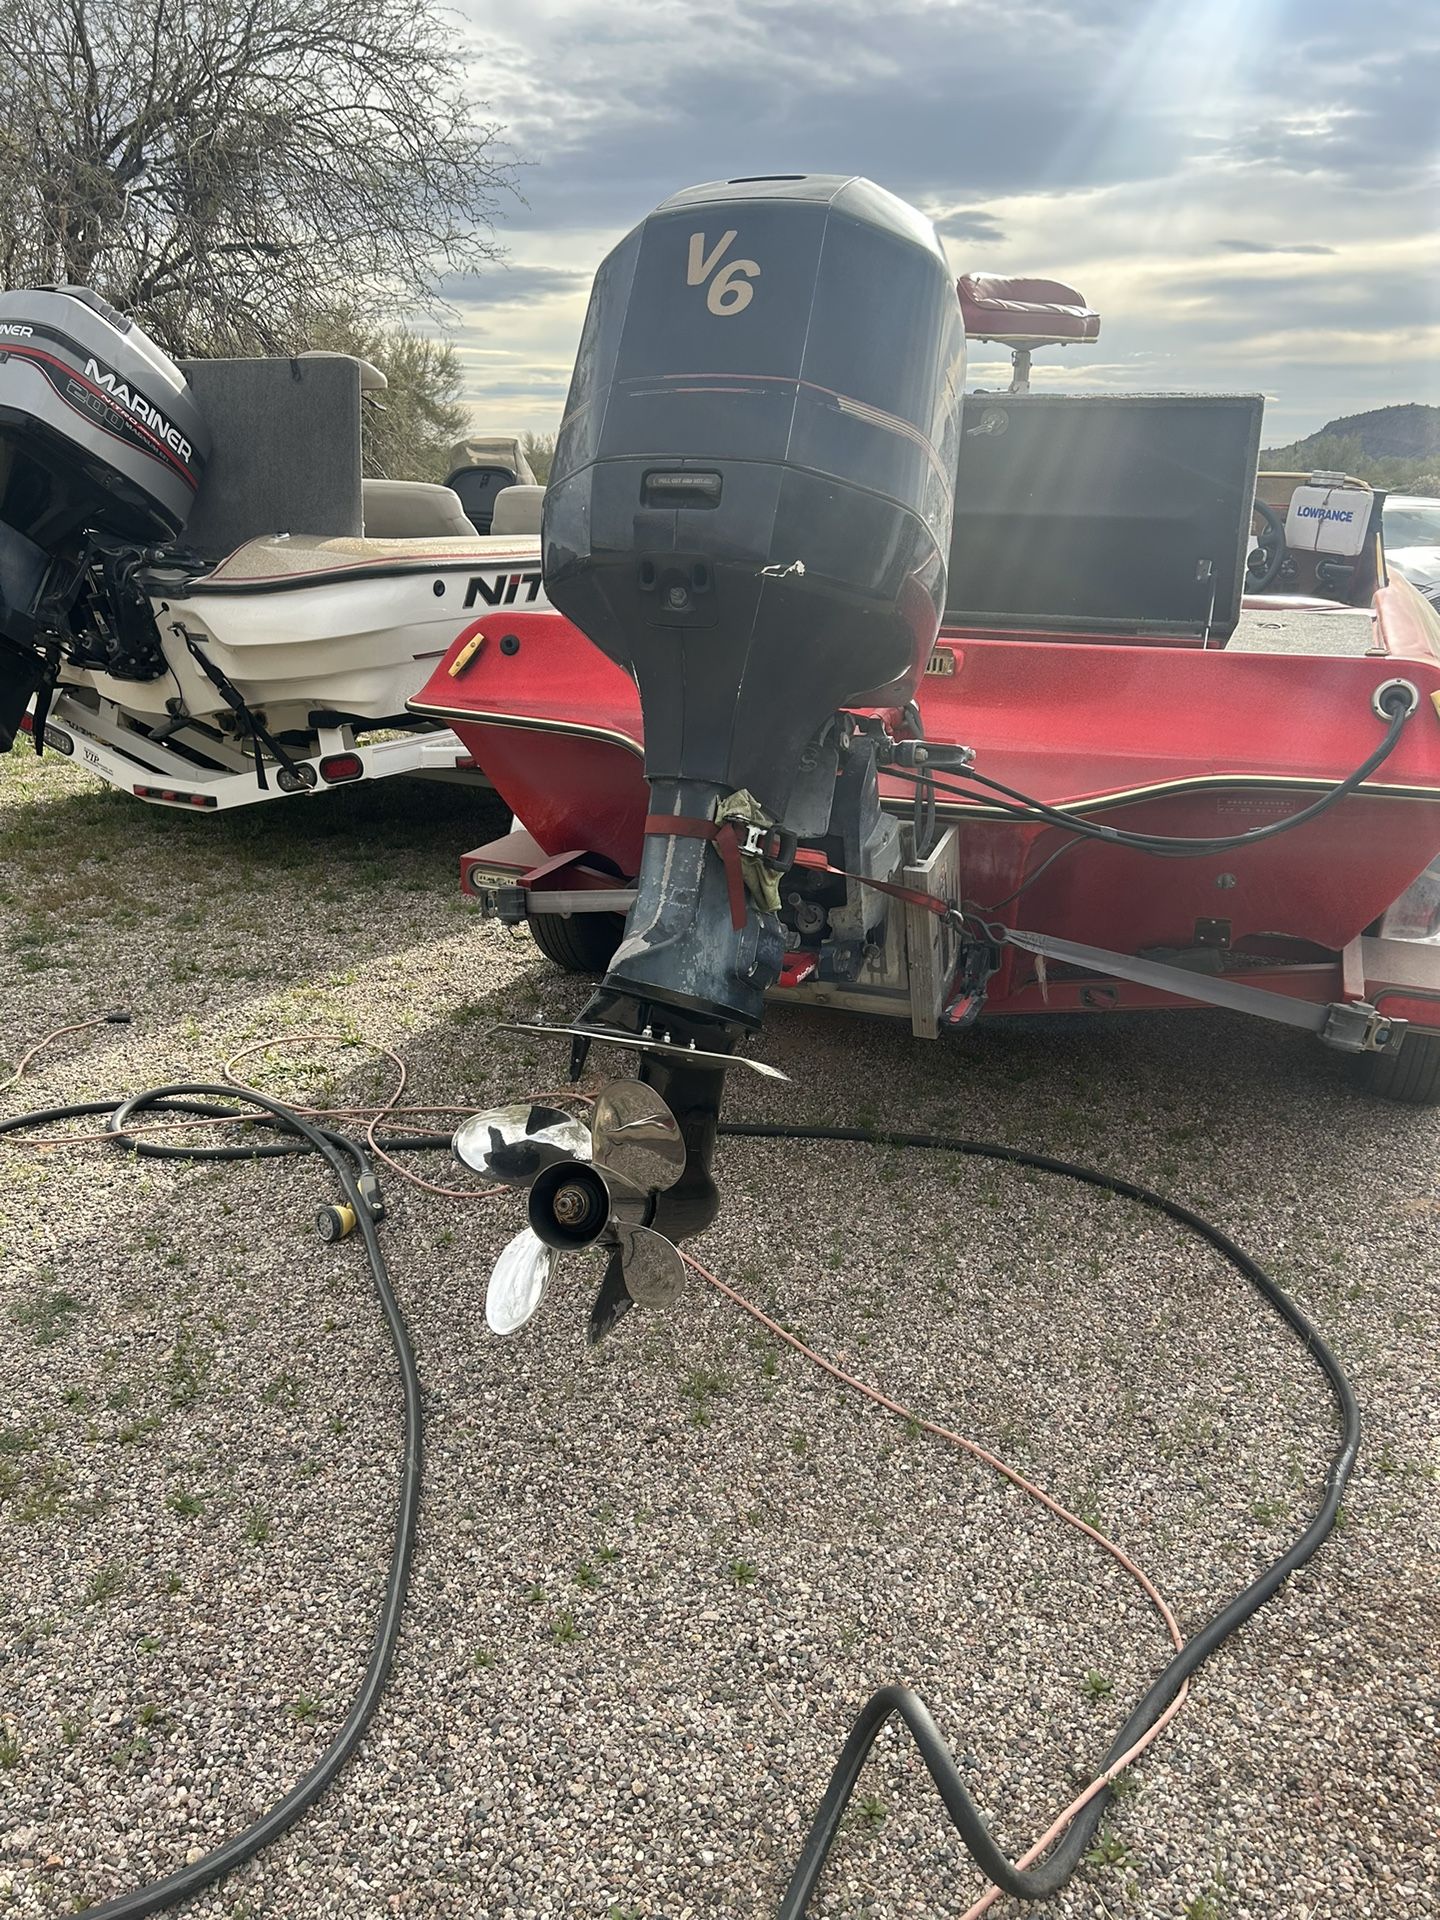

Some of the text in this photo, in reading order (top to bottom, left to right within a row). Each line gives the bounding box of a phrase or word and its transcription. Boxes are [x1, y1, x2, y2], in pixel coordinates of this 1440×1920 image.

[687, 230, 761, 316] V6
[66, 378, 125, 431] 200
[84, 358, 192, 464] MARINER
[101, 394, 138, 426] NITRO
[1296, 506, 1354, 523] LOWRANCE
[462, 572, 542, 609] NIT
[84, 748, 100, 763] VIP
